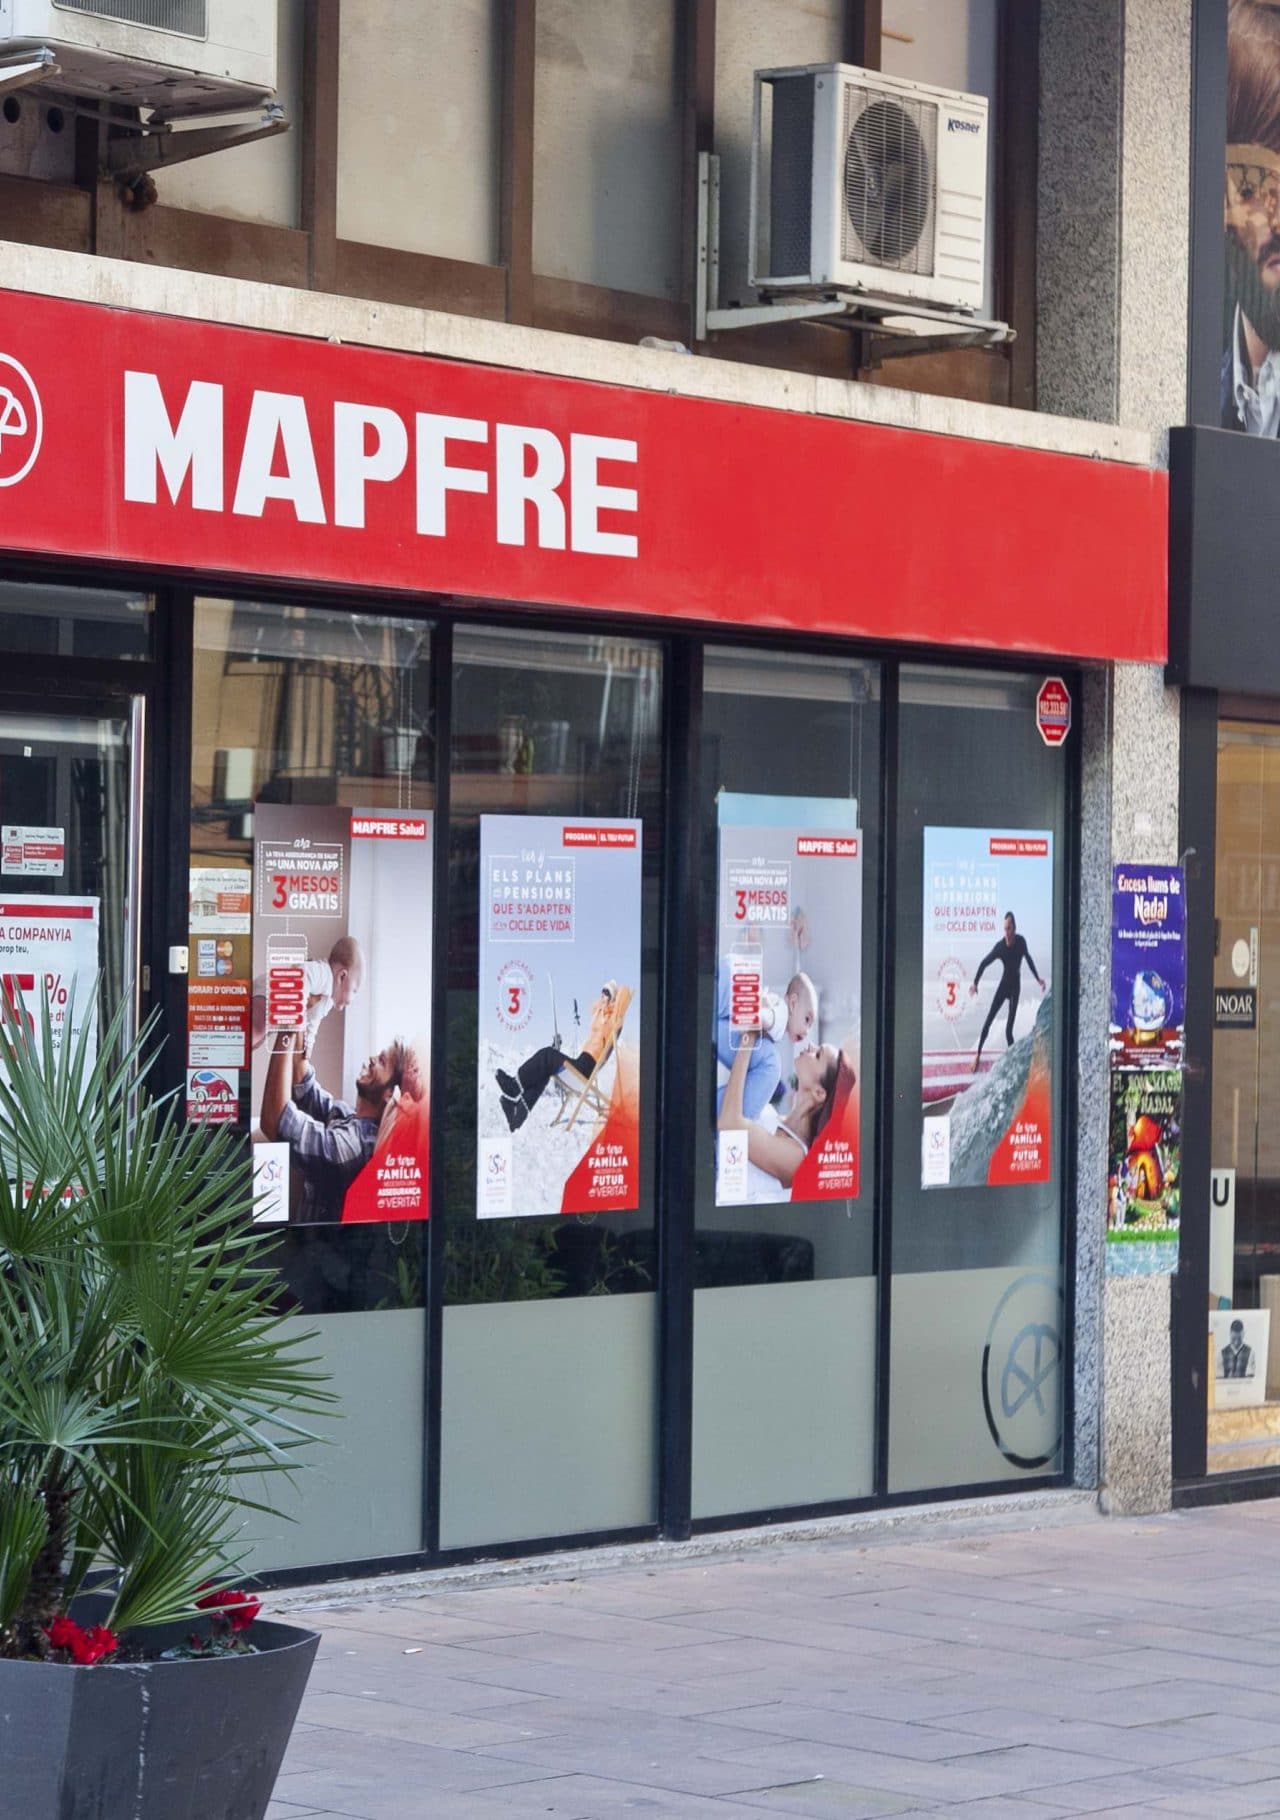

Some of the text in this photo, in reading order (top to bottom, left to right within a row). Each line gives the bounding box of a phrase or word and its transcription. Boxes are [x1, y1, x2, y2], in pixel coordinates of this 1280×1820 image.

[947, 117, 980, 133] Kosner
[124, 370, 638, 558] MAPFRE
[353, 821, 425, 836] MAPFRE Salud
[799, 840, 856, 853] MAPFRE Salud
[277, 860, 338, 871] UNA NOVA APP
[493, 869, 572, 883] ELS PLANS
[1118, 874, 1180, 894] Encesa llums de
[272, 875, 288, 909] 3
[289, 876, 338, 892] MESOS
[503, 886, 571, 899] PENSIONS
[288, 893, 338, 910] GRATIS
[493, 903, 571, 914] QUE S'ADAPTEN
[735, 890, 787, 920] 3 MESOS
[748, 905, 788, 921] GRATIS
[934, 906, 950, 917] QUE
[1134, 893, 1168, 925] Nadal
[509, 920, 571, 931] CICLE DE VIDA
[980, 921, 996, 932] VIDA
[9, 927, 72, 941] COMPANYIA
[15, 944, 29, 954] teu,
[508, 987, 520, 1014] 3
[946, 982, 956, 1006] 3
[1216, 994, 1253, 1013] INOAR
[588, 1155, 628, 1168] FAMÍLIA
[377, 1166, 421, 1180] FAMÍLIA
[593, 1174, 624, 1186] FUTUR
[596, 1185, 628, 1197] VERITAT
[1213, 1178, 1230, 1207] U
[386, 1196, 421, 1208] VERITAT
